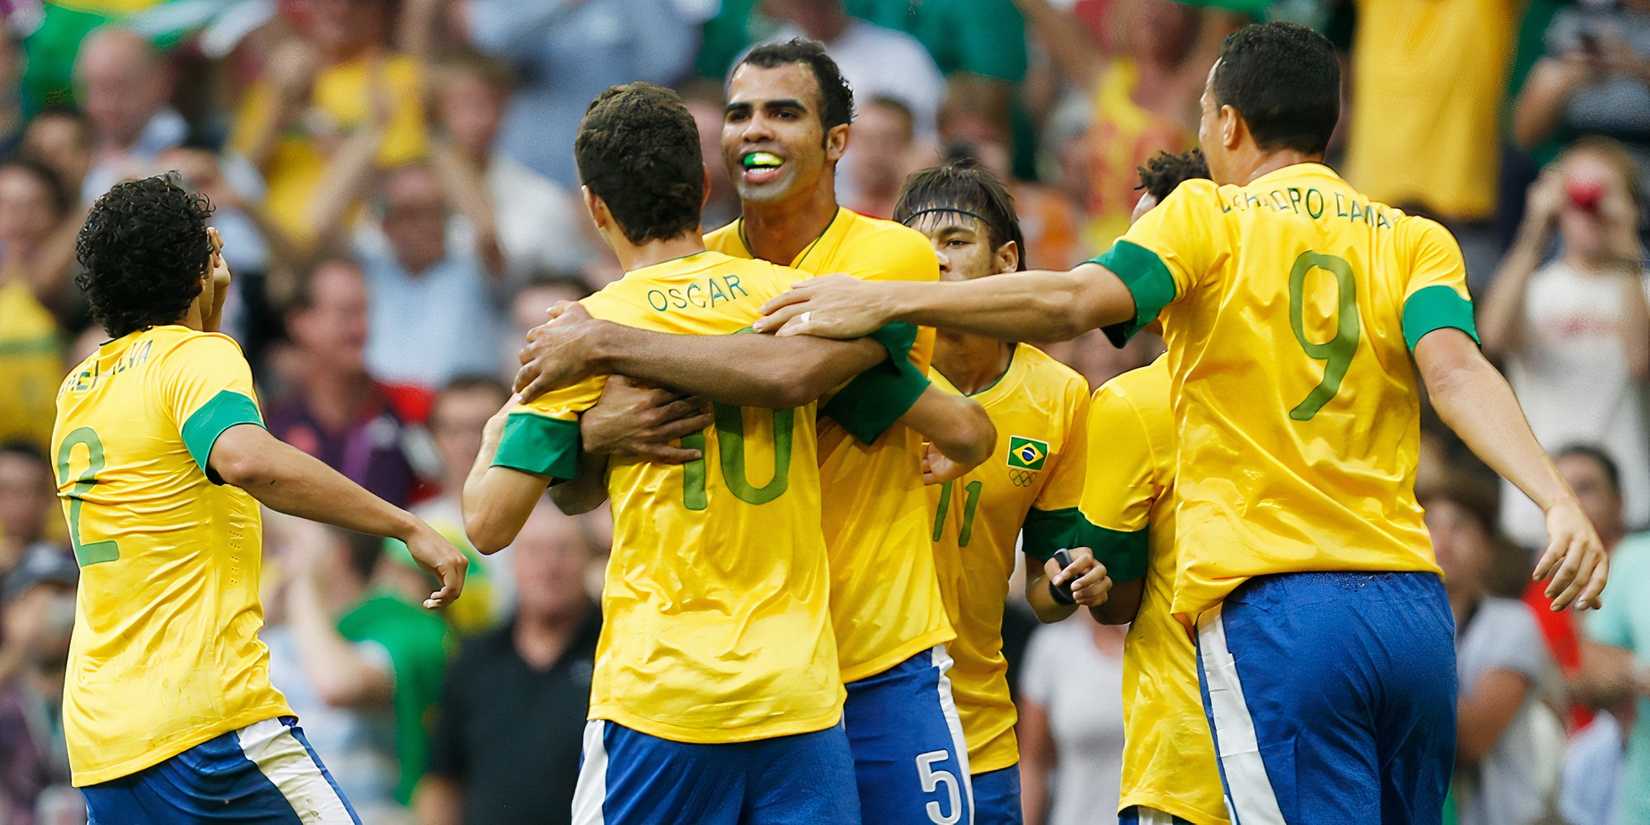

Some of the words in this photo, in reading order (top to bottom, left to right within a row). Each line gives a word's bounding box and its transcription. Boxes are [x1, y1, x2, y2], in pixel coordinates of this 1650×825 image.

[647, 274, 748, 312] OSCAR
[1289, 249, 1360, 421] 9
[57, 426, 120, 568] 2
[932, 479, 982, 548] 11
[915, 749, 962, 825] 5
